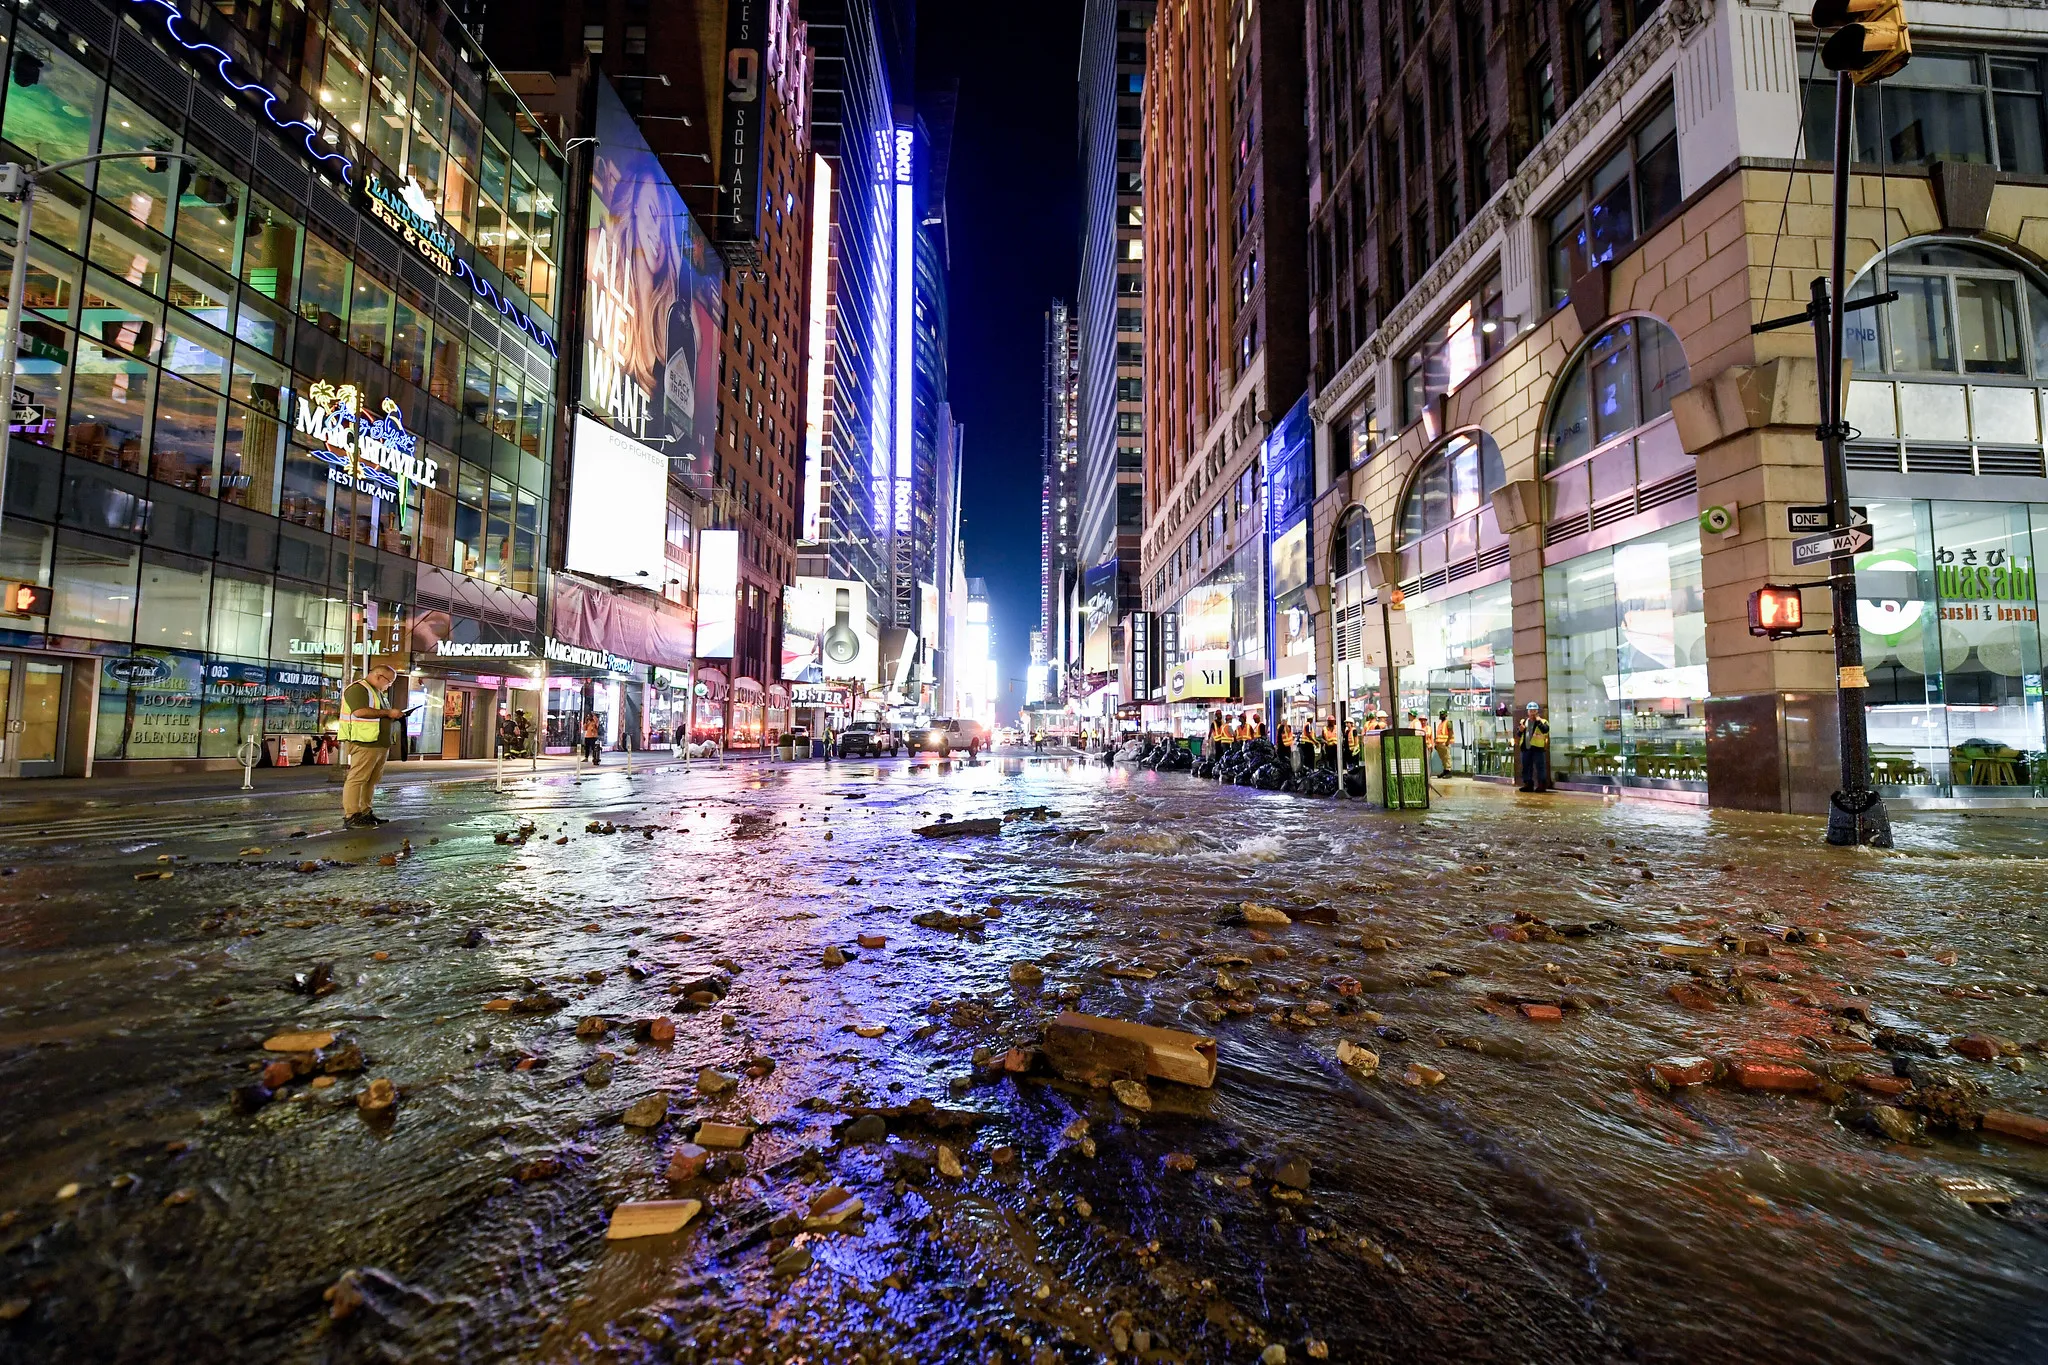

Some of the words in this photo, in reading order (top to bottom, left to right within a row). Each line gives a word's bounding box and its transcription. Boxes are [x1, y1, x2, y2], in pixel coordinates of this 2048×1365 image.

[728, 48, 759, 102] 9
[733, 110, 745, 224] SQUARE
[371, 179, 456, 260] LANDSHARK
[370, 198, 401, 233] Bar
[403, 226, 416, 247] &
[418, 240, 453, 276] Grill
[592, 227, 635, 318] ALL
[591, 278, 628, 366] WE
[1845, 327, 1876, 341] PNB
[40, 342, 47, 355] 7
[588, 339, 651, 441] WANT
[669, 370, 691, 396] BLACK
[670, 382, 690, 406] IRISH
[15, 411, 34, 419] WAY
[609, 435, 628, 450] FOO
[629, 444, 665, 468] FIGHTERS
[1795, 514, 1820, 525] ONE
[1798, 543, 1821, 557] ONE
[1832, 534, 1861, 550] WAY
[1936, 546, 2006, 567] わさび
[1936, 555, 2036, 601] wasabi
[1939, 603, 1979, 621] sushi
[1997, 603, 2037, 622] bento
[1135, 612, 1146, 651] YARD
[436, 640, 530, 657] MARGARITAVILLE
[544, 636, 608, 668] MARGARITAVILLE
[608, 655, 635, 674] Resort
[1135, 652, 1146, 700] HOUSE
[143, 694, 193, 708] BOOZE
[791, 688, 842, 705] OBSTER
[143, 713, 160, 725] IN
[162, 714, 192, 725] THE
[268, 719, 318, 730] PARDISE
[133, 731, 198, 744] BLENDER
